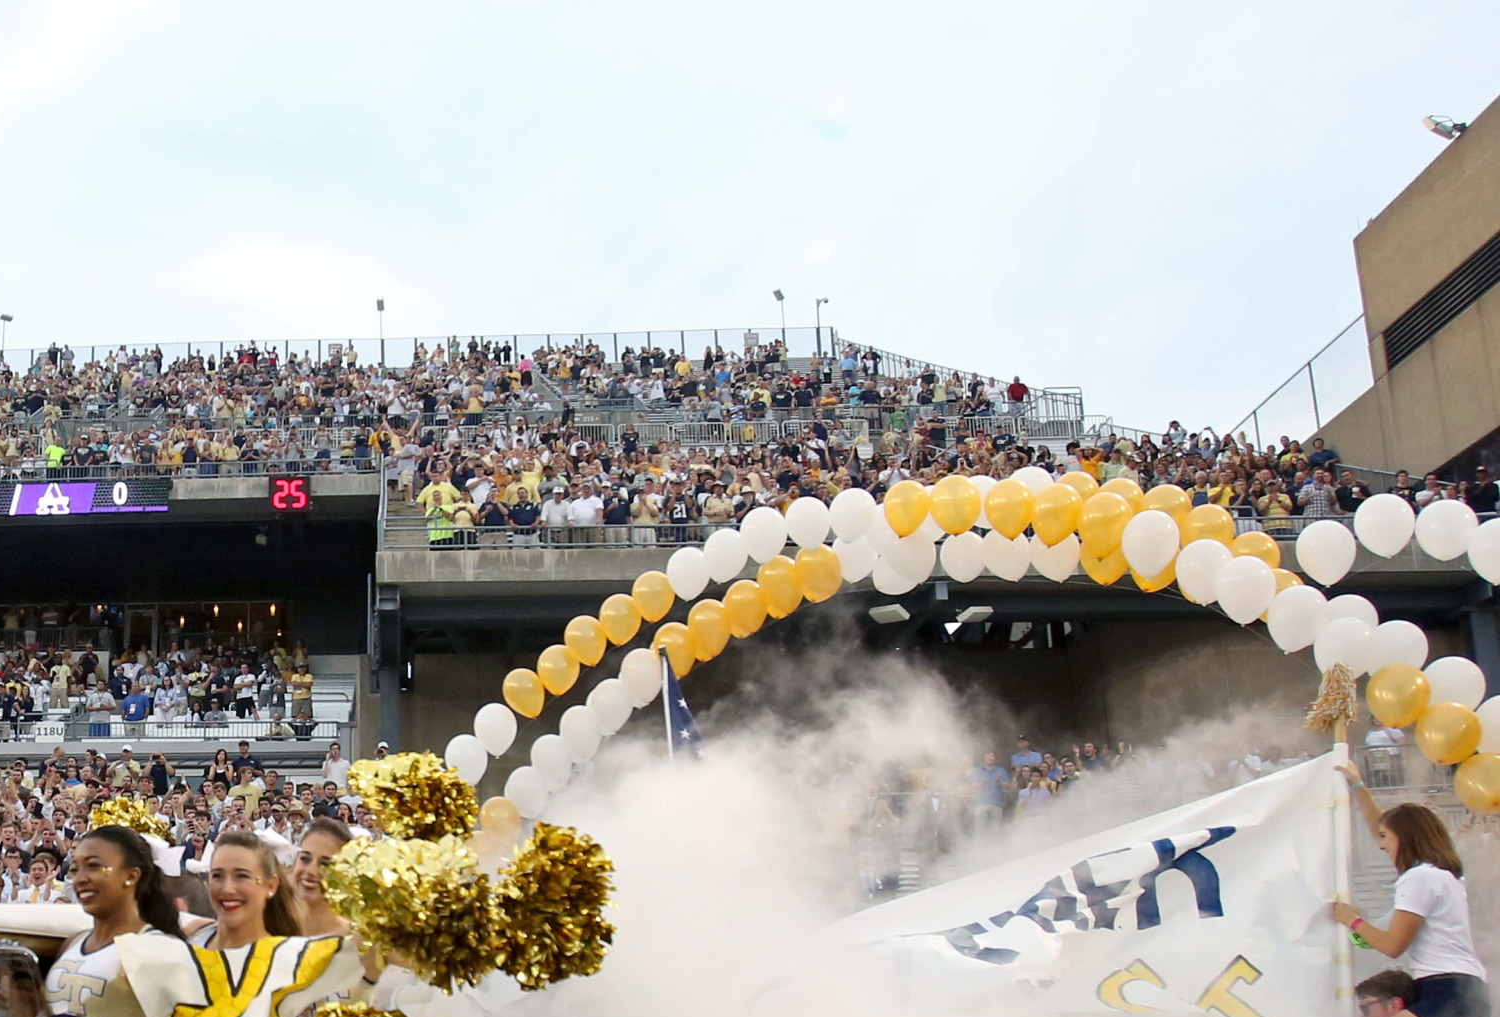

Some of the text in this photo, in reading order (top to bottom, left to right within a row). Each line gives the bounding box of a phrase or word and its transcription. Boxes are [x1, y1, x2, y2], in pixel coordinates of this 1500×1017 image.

[112, 482, 128, 506] 0
[272, 479, 307, 509] 25
[673, 503, 687, 519] 21
[37, 727, 64, 736] 118U
